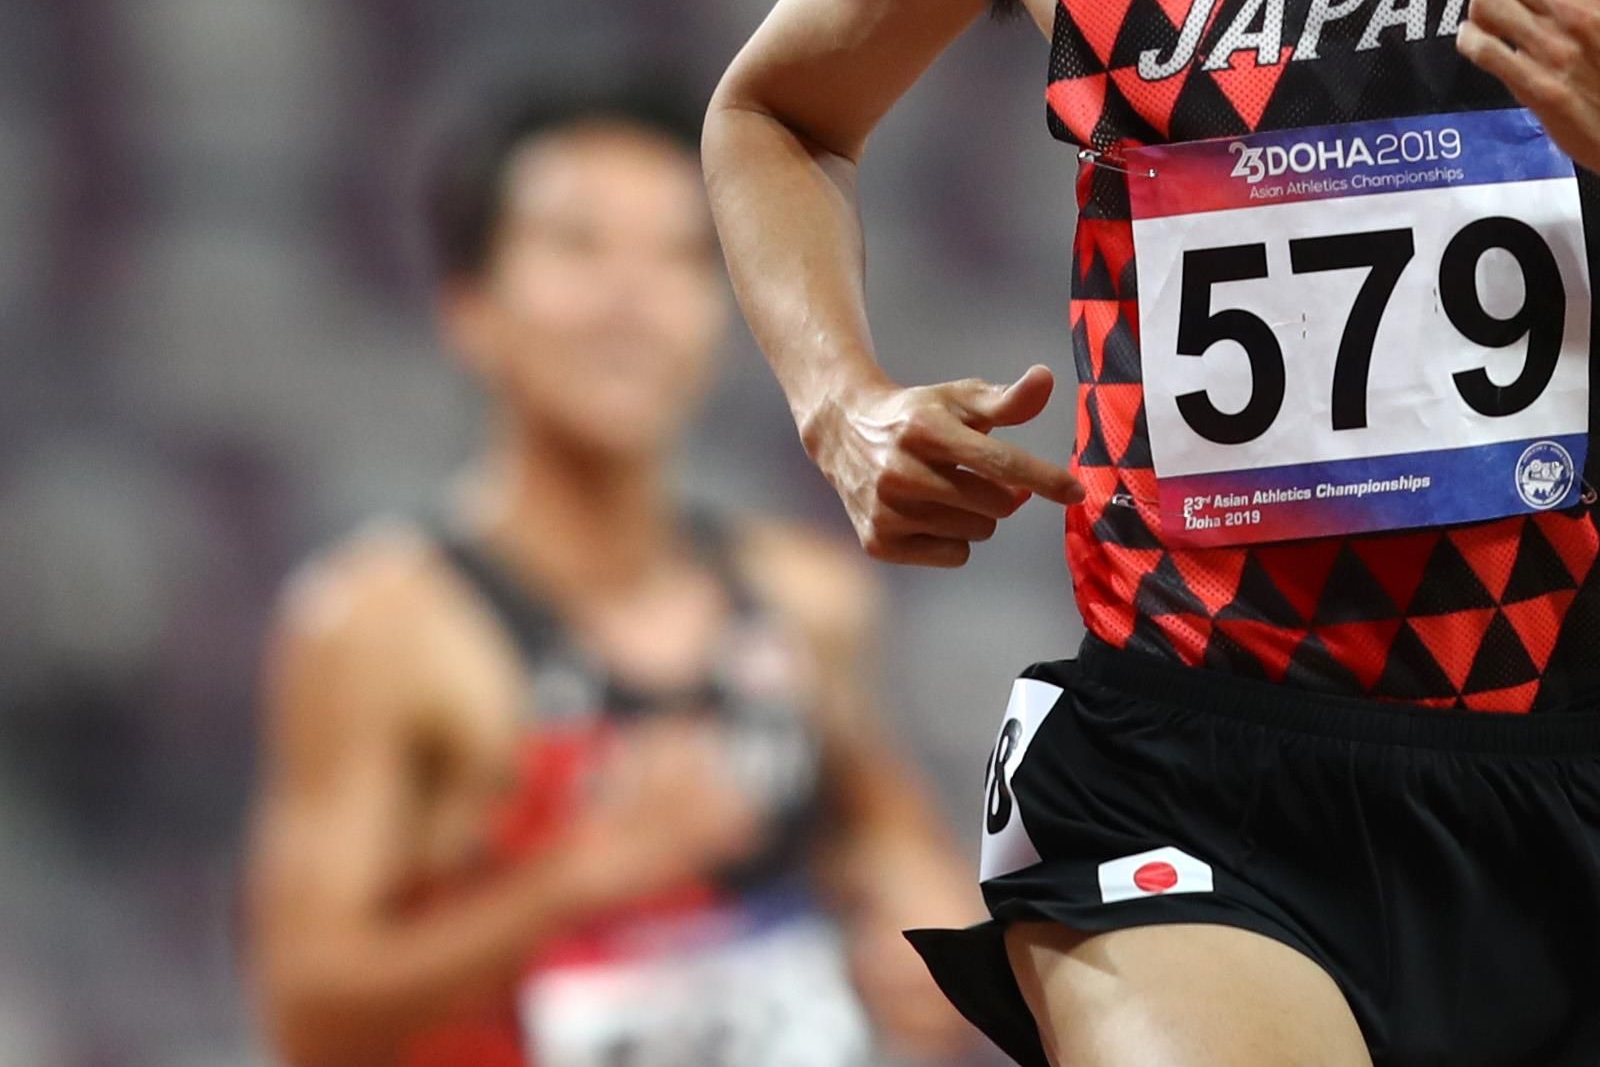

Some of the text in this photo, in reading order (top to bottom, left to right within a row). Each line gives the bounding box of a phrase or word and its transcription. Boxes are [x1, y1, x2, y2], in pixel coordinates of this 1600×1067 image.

[1250, 166, 1464, 200] Asian Athletics Championships
[1175, 216, 1566, 445] 579
[1213, 493, 1249, 509] Asian
[1252, 486, 1311, 505] Athletics
[1316, 475, 1431, 498] Championships
[1225, 509, 1261, 527] 2019
